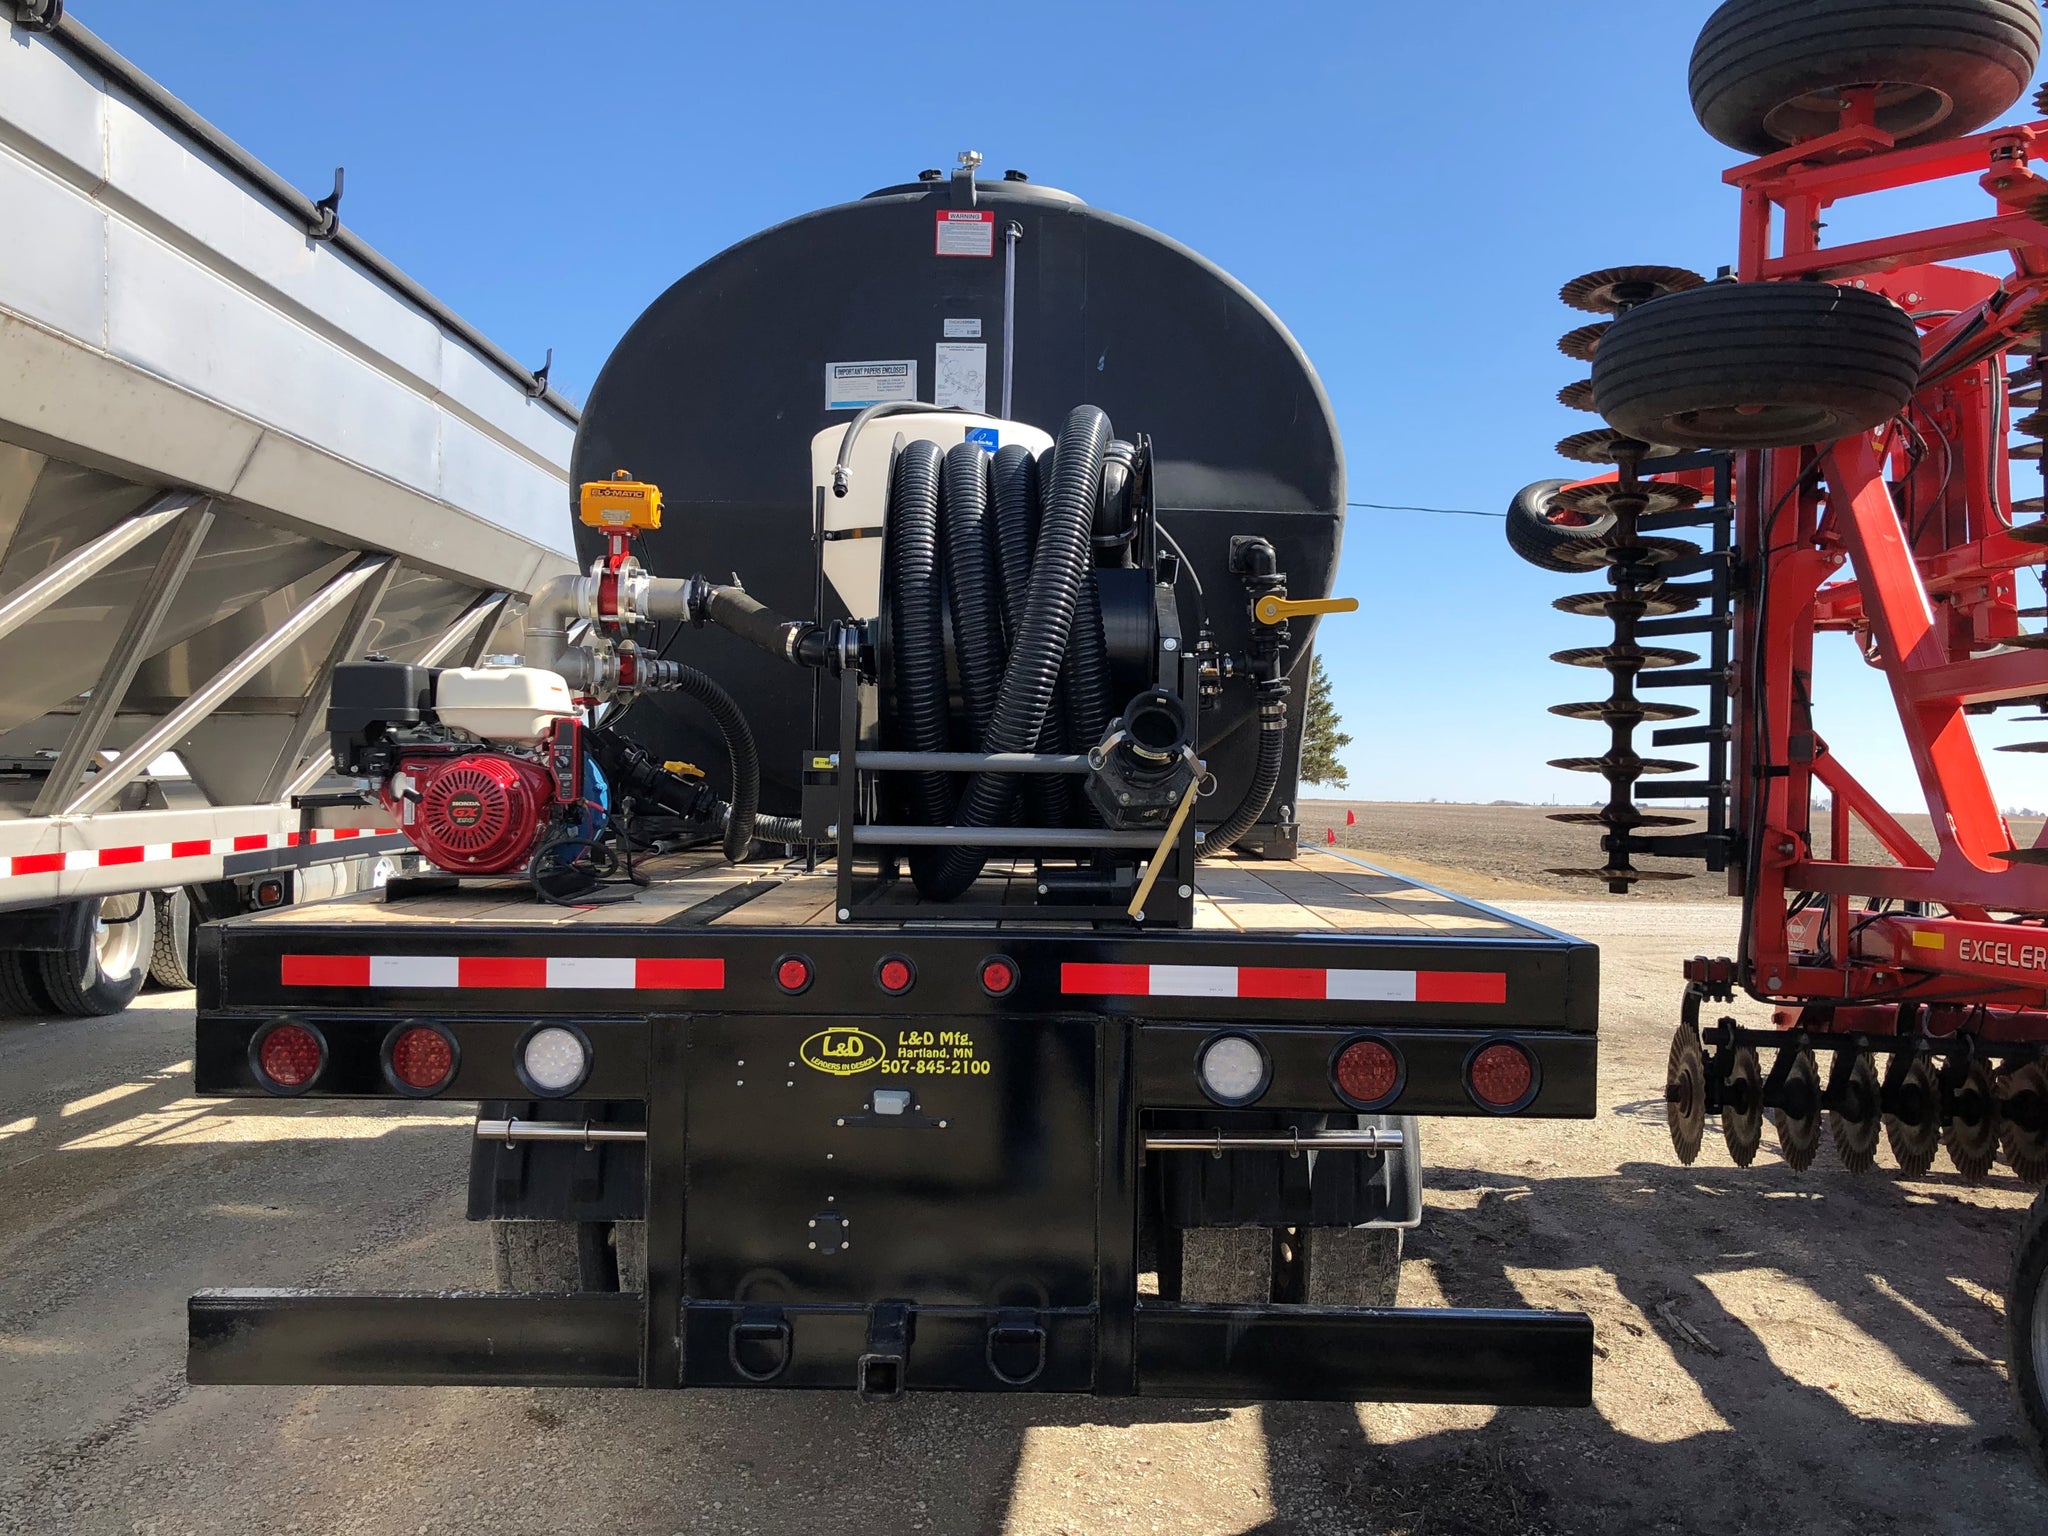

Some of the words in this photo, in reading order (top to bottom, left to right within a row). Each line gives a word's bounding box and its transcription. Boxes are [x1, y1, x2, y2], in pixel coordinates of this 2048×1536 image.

[837, 367, 863, 376] IMPORTANT
[864, 367, 882, 375] PAPERS
[882, 366, 905, 375] ENCLOSED
[452, 807, 479, 817] GX
[823, 1035, 864, 1057] L&D
[898, 1031, 935, 1046] L&D
[940, 1031, 973, 1046] Mfg.
[898, 1047, 950, 1059] Hartland,
[953, 1047, 974, 1058] MN
[810, 1056, 841, 1071] LEADERS
[850, 1056, 876, 1070] DESIGN
[880, 1059, 991, 1074] 507-845-2100
